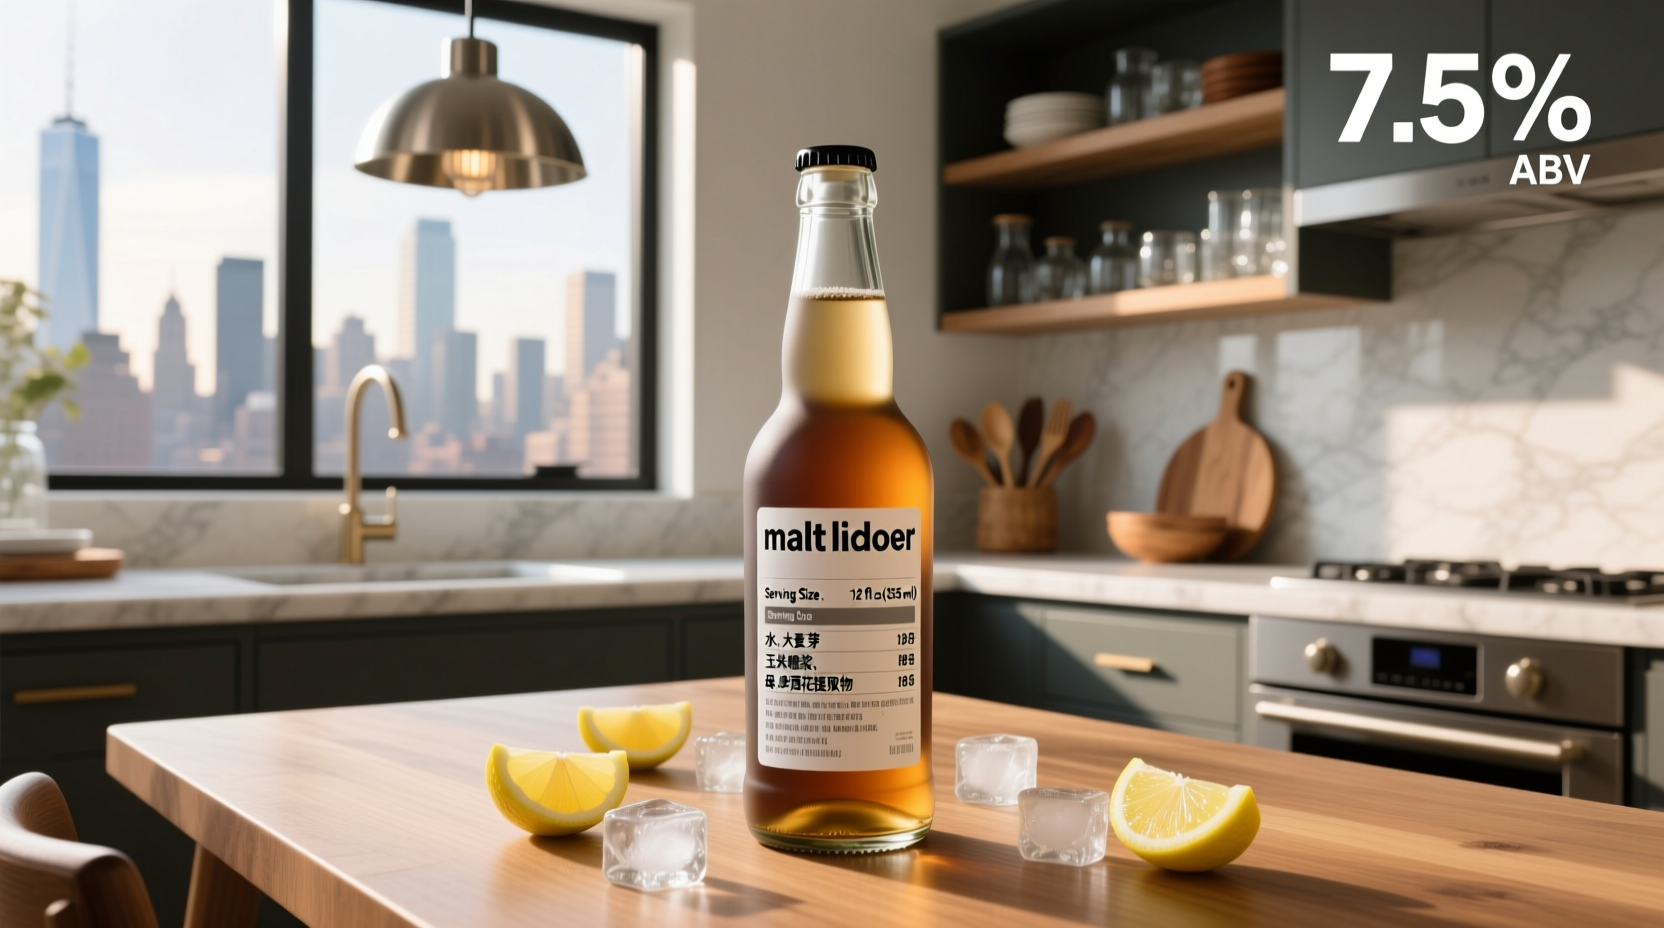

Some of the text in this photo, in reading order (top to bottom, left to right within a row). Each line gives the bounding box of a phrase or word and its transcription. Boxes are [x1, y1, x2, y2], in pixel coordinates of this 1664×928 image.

[764, 520, 916, 552] malt lidoer
[765, 587, 797, 604] Serving
